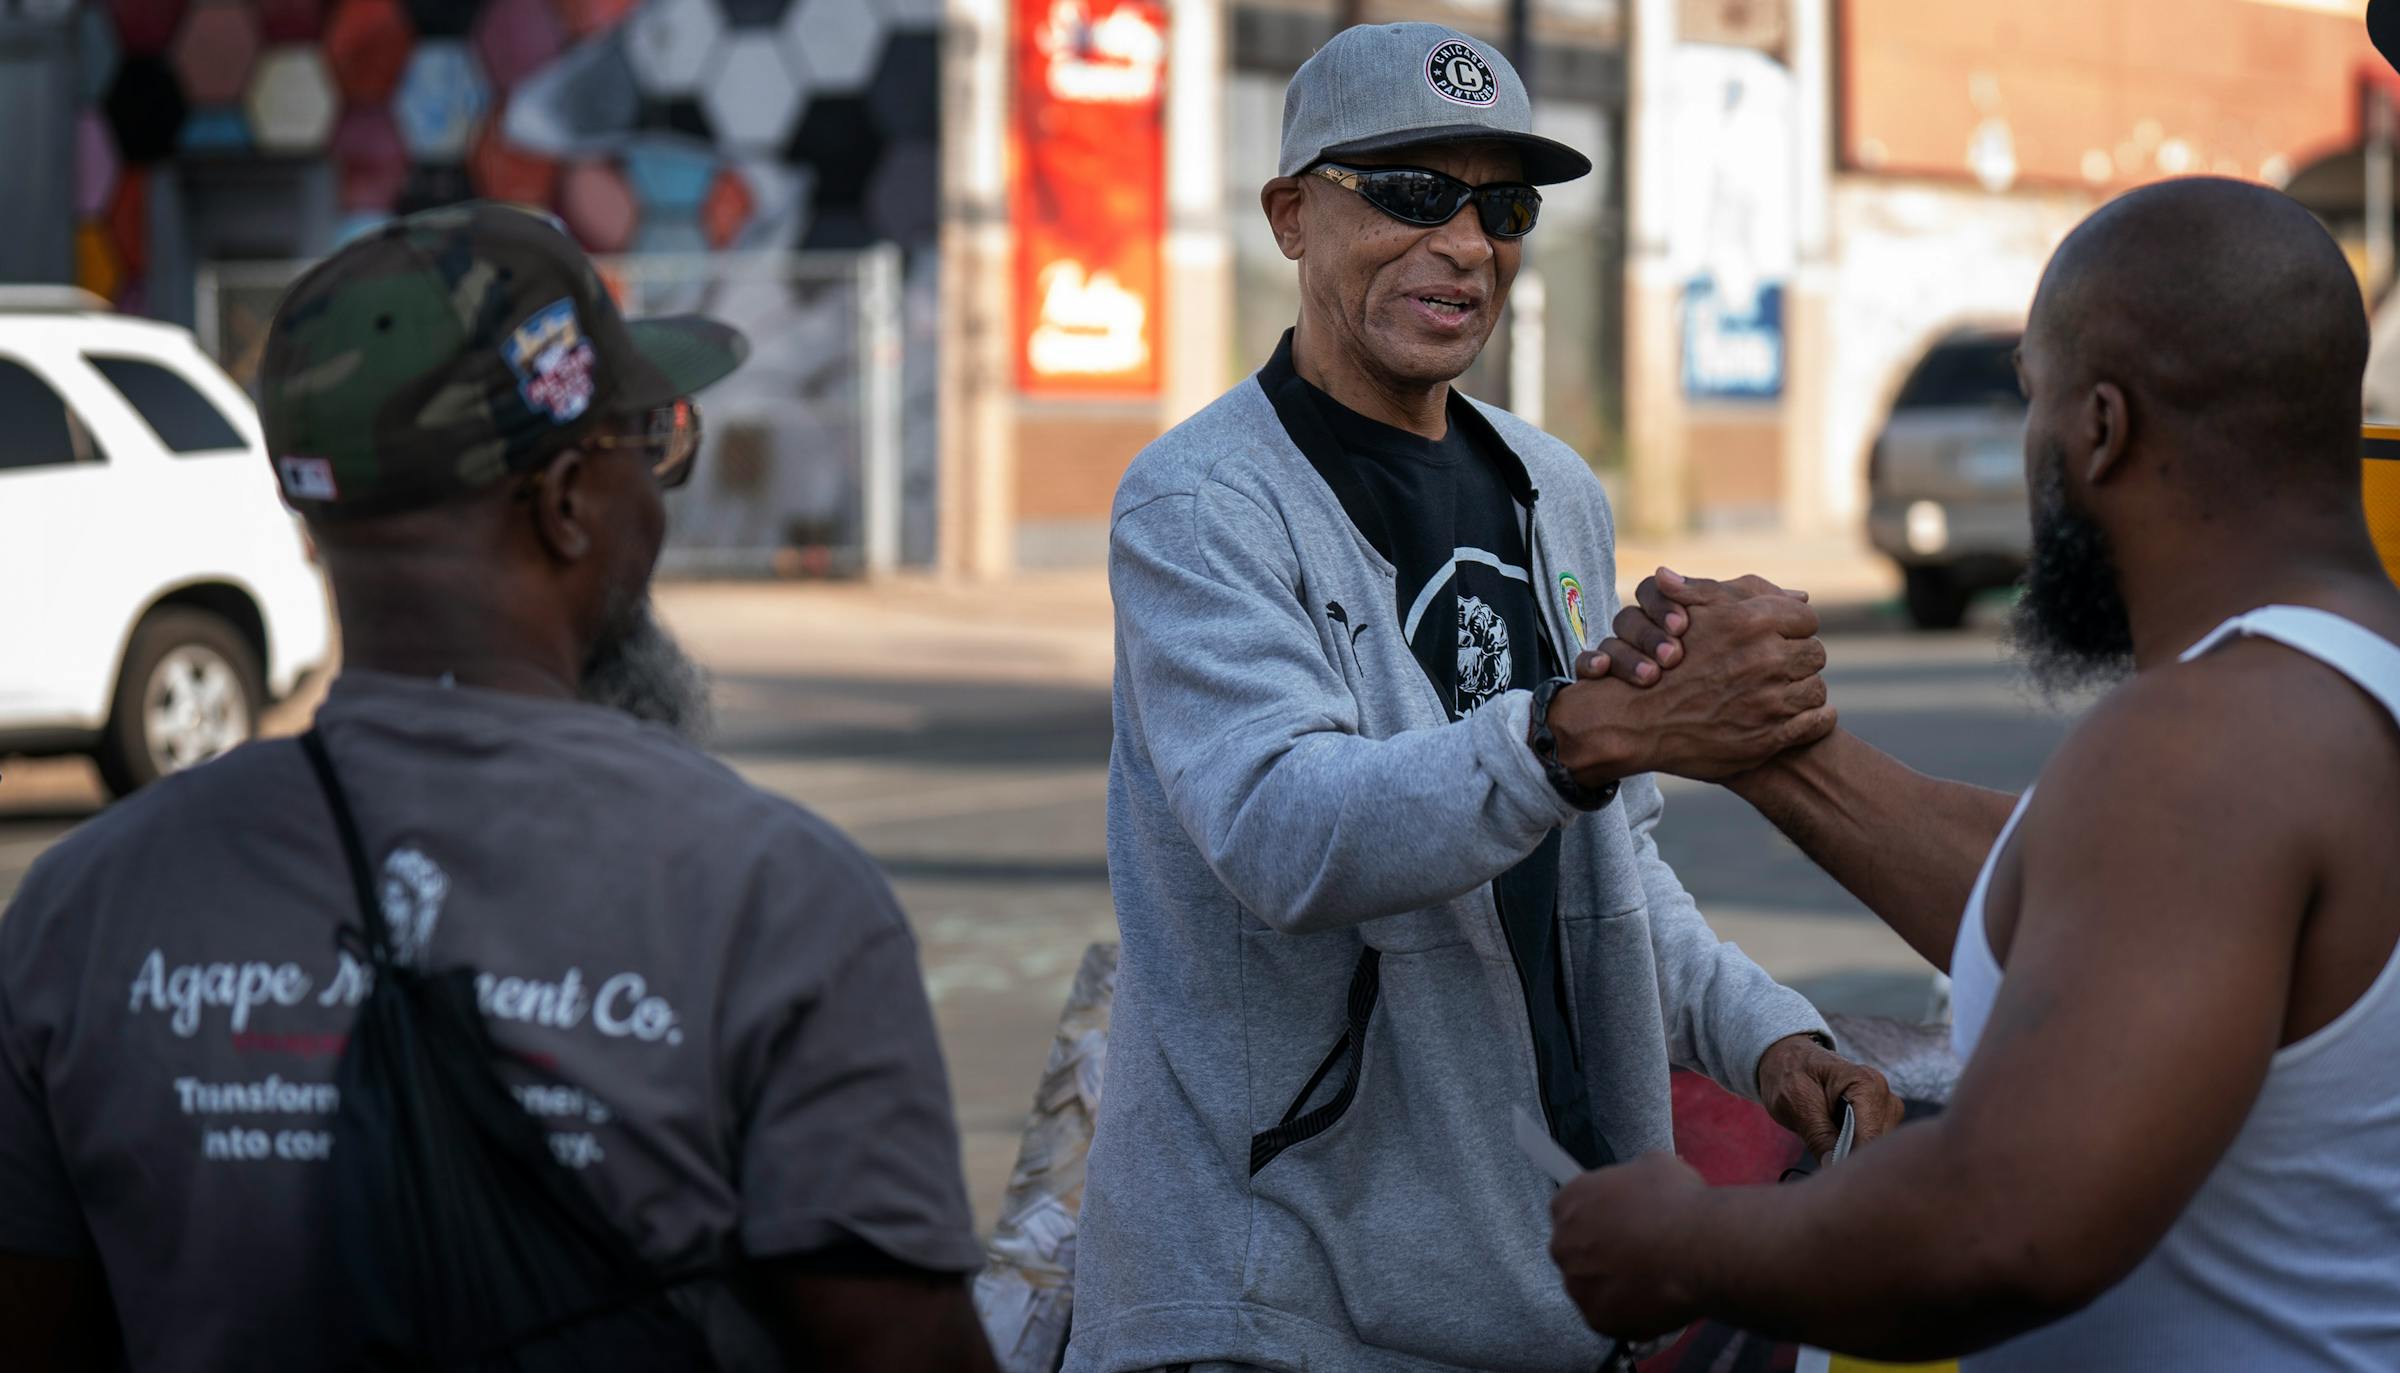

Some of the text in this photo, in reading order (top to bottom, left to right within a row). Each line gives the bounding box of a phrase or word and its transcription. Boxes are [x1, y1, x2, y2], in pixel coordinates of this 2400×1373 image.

[1434, 45, 1485, 69] CHICAGO
[1454, 60, 1477, 87] C
[1437, 80, 1494, 101] PANTHERS
[129, 947, 312, 1038] Agape
[592, 971, 684, 1047] Co.
